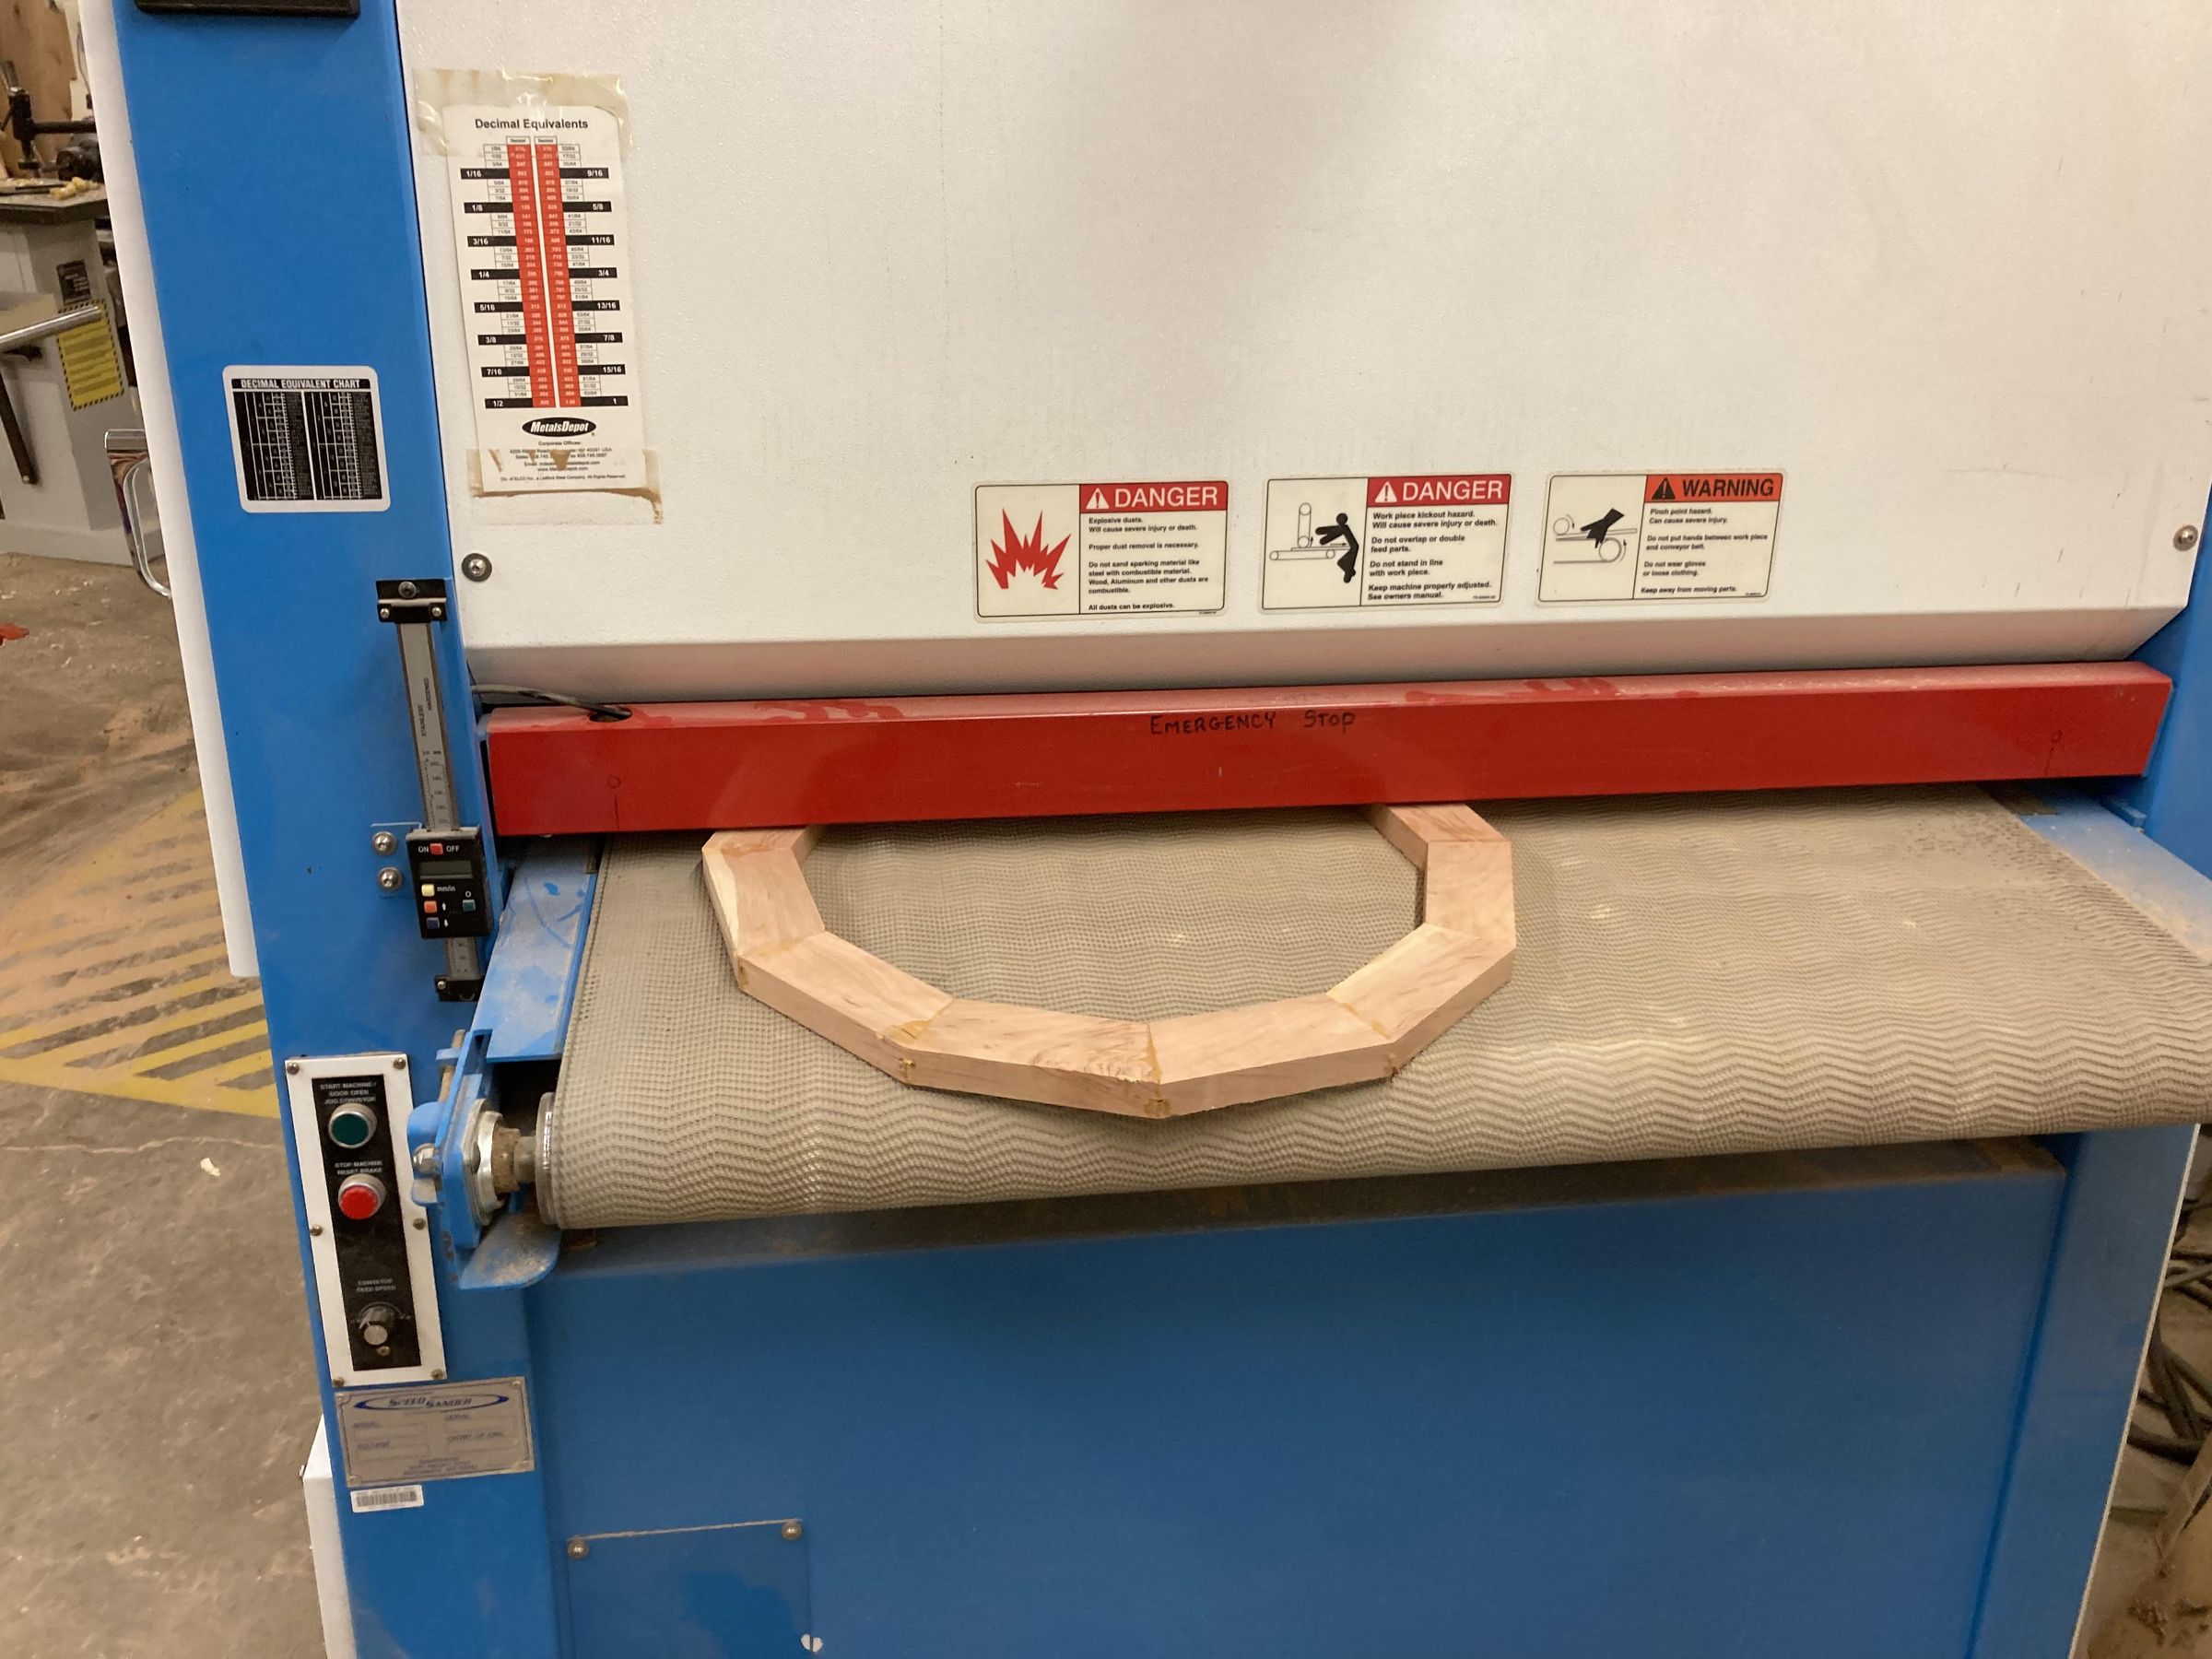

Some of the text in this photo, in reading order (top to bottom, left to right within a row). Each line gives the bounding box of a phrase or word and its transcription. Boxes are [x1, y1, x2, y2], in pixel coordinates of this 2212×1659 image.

[476, 119, 589, 131] Decimal Equivalents
[597, 301, 616, 310] 13/16
[485, 335, 497, 344] 3/8
[487, 368, 502, 376] 7/16
[603, 366, 622, 374] 15/16
[241, 379, 360, 389] DECIMAL EQUIVALENT CHART
[492, 399, 503, 407] 1/2
[530, 421, 589, 433] MetalsDepot
[1402, 480, 1503, 501] DANGER
[1682, 478, 1774, 498] WARNING
[1115, 487, 1218, 508] DANGER
[1088, 517, 1122, 525] Explosive
[1394, 512, 1417, 521] piece
[1417, 511, 1446, 519] kickout
[1371, 521, 1387, 529] Will
[1440, 519, 1463, 529] injury
[1371, 536, 1382, 545] Do
[1398, 535, 1428, 545] overlap
[1438, 534, 1465, 542] double
[1129, 560, 1159, 569] sparking
[1429, 559, 1443, 567] line
[1368, 583, 1389, 593] Keep
[1389, 582, 1422, 591] machine
[1423, 582, 1455, 592] properly
[1367, 593, 1382, 601] See
